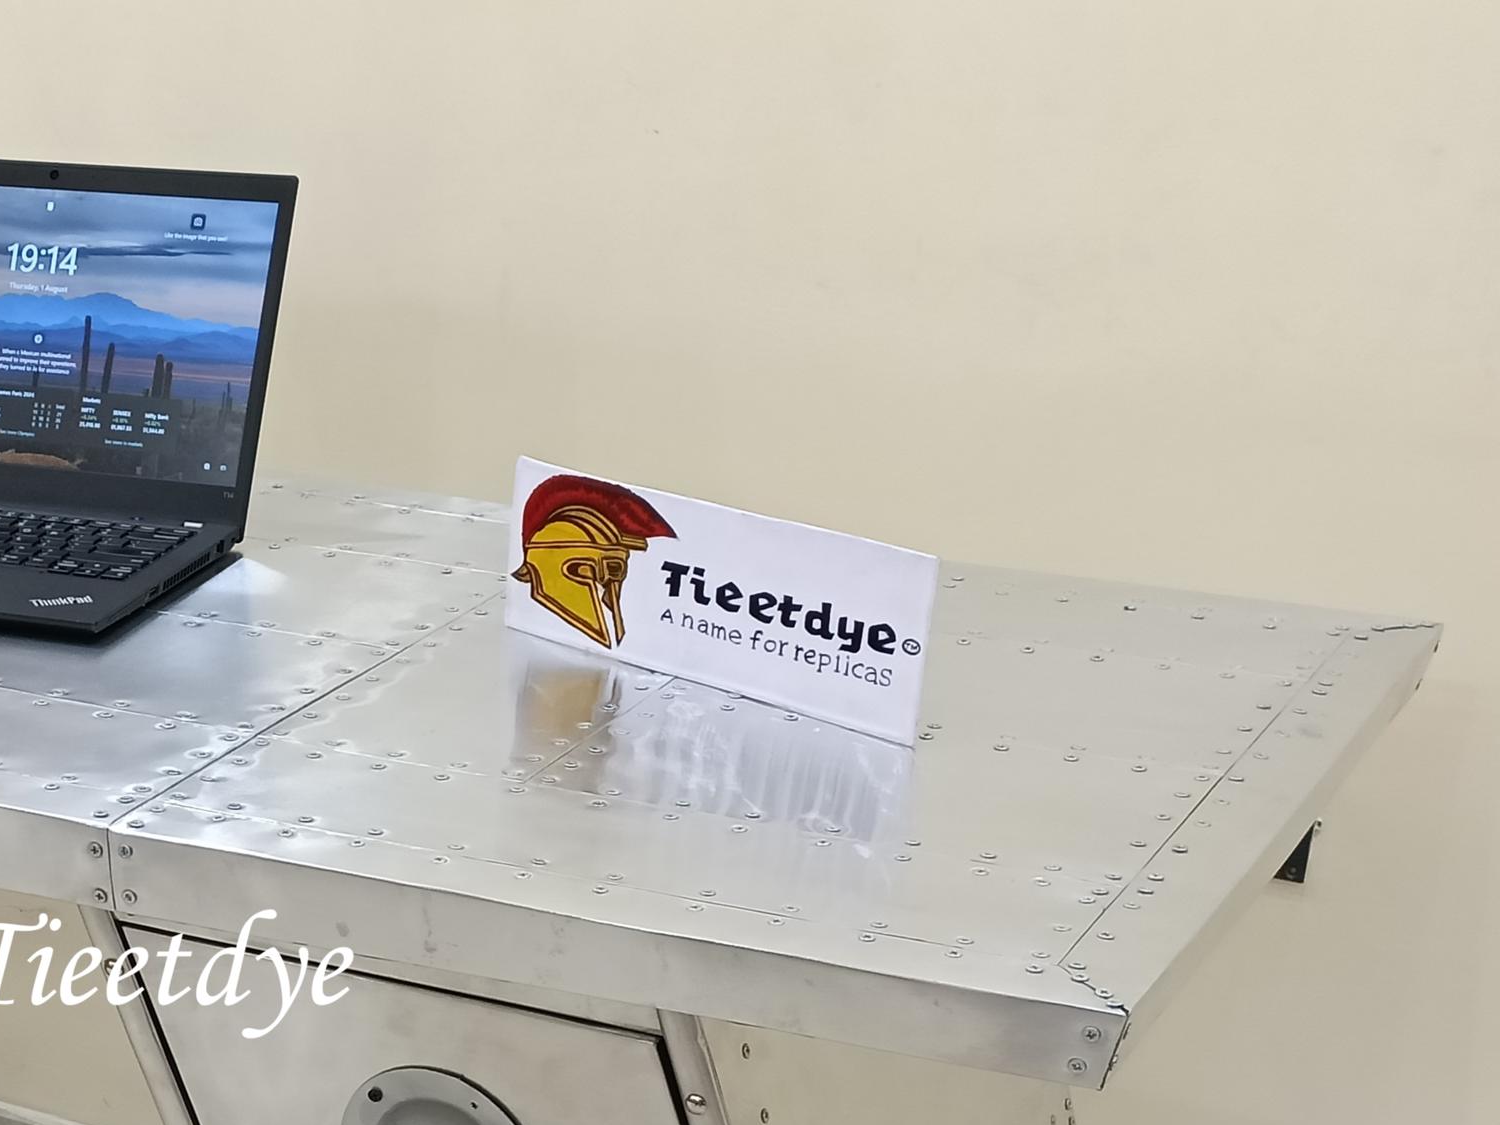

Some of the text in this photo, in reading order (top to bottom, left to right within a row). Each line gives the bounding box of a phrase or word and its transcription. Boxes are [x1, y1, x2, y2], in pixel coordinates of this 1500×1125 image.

[7, 242, 78, 276] 19:14
[45, 284, 68, 294] August
[29, 595, 93, 607] ThinkPad
[660, 560, 897, 656] Tieetdye
[660, 608, 893, 688] A name for replicas
